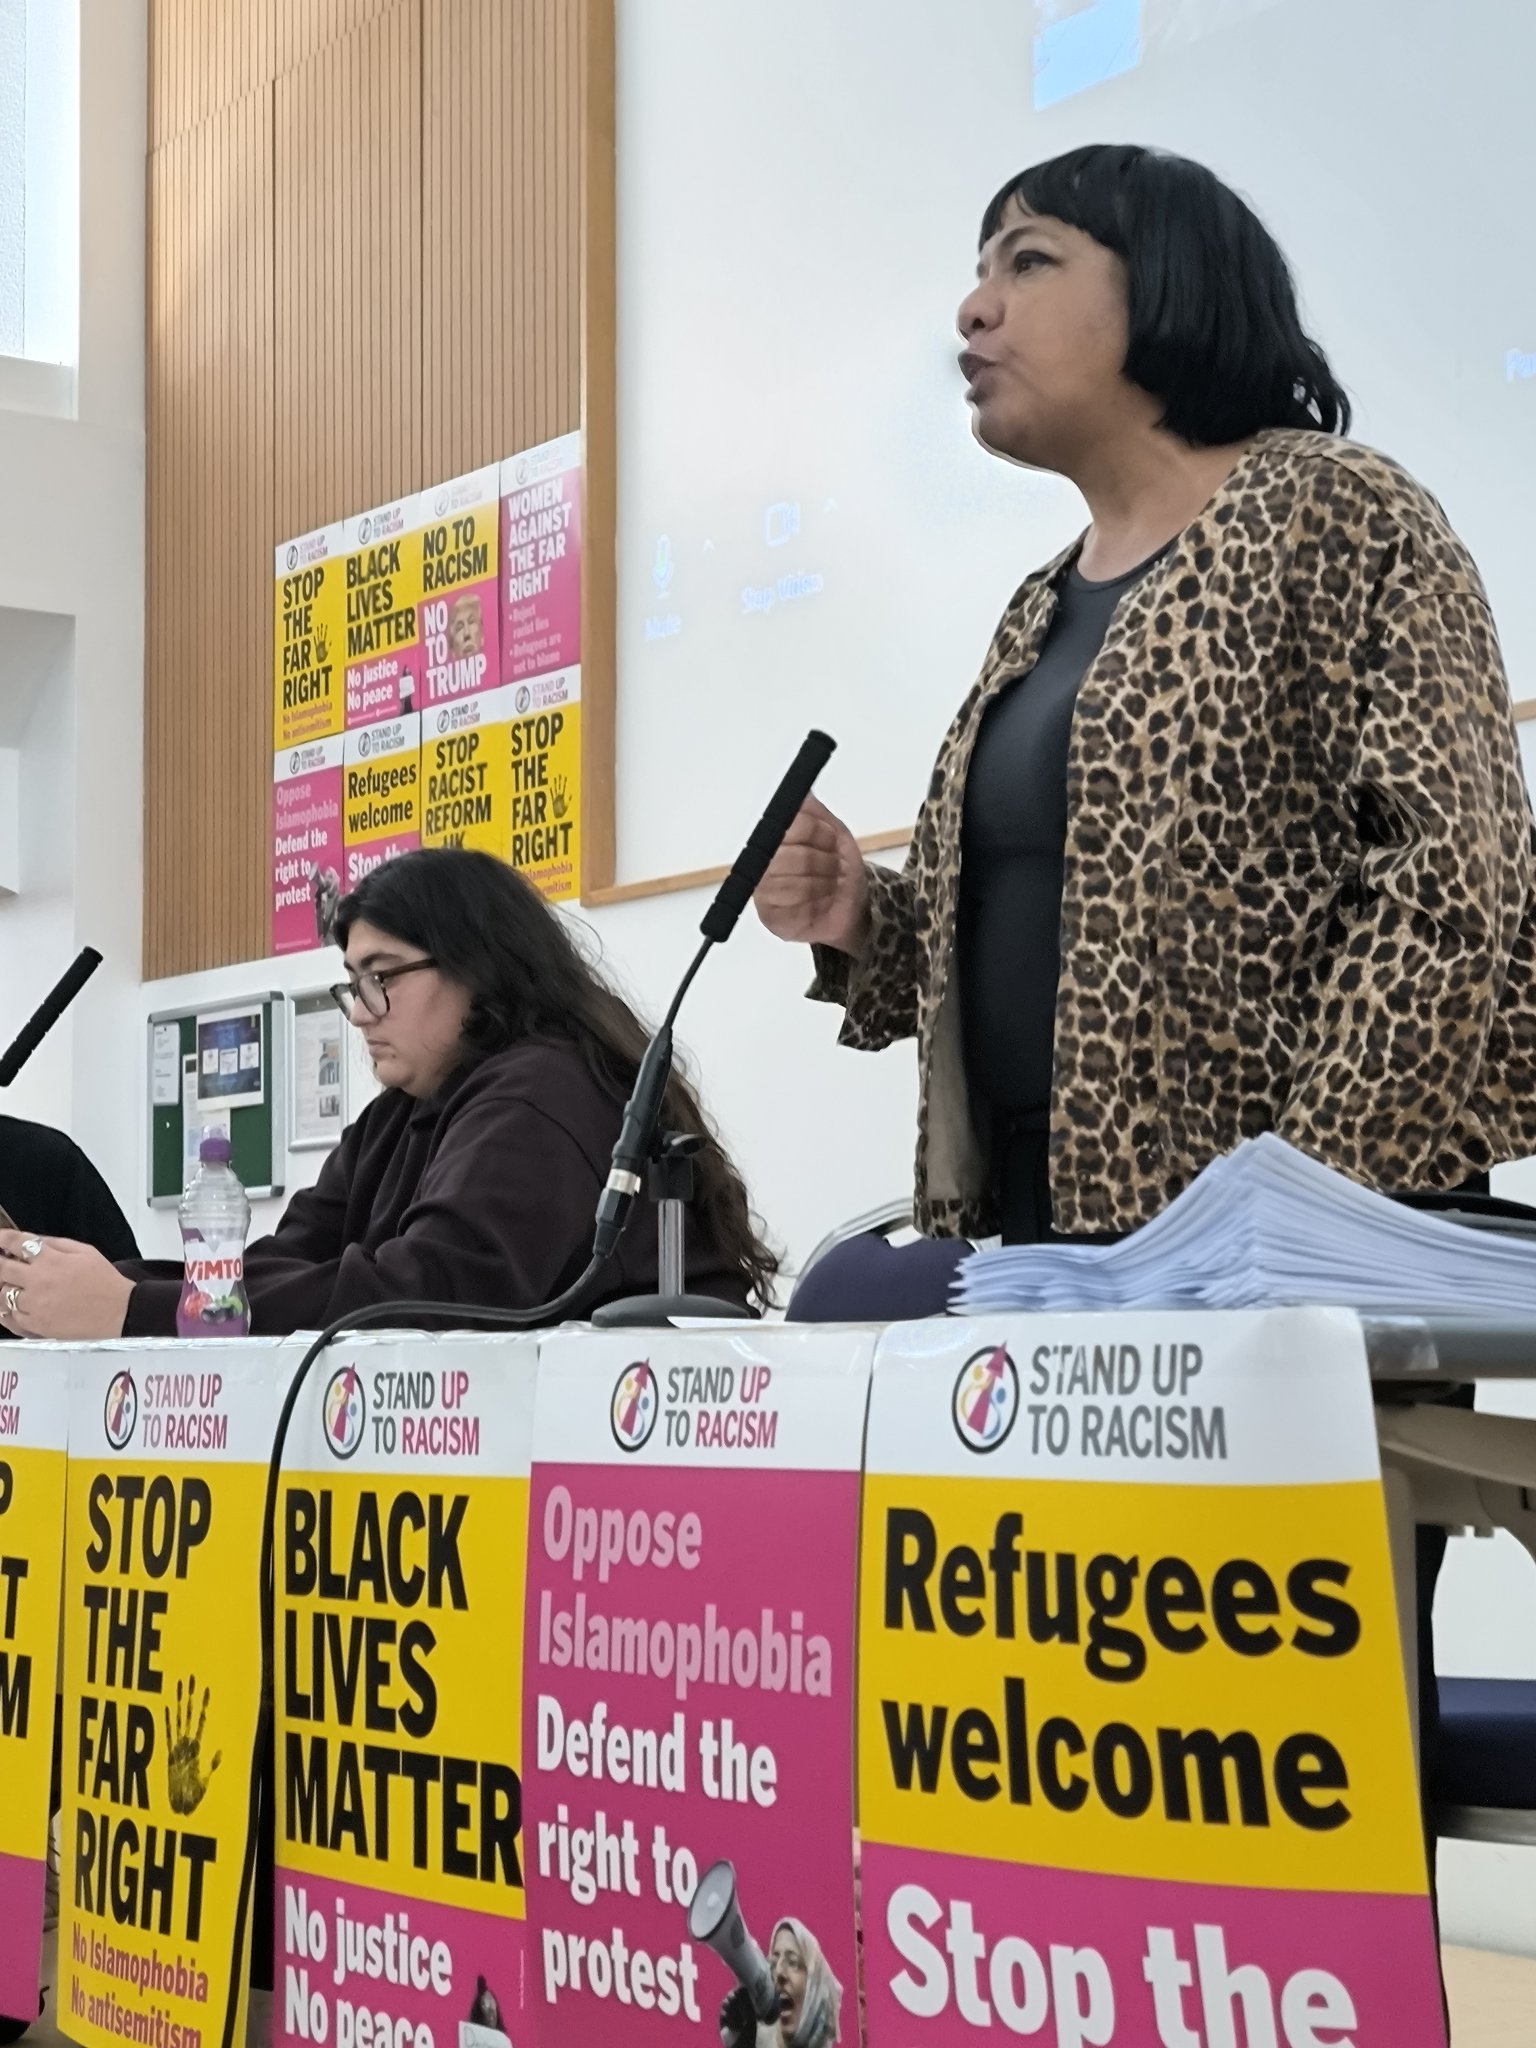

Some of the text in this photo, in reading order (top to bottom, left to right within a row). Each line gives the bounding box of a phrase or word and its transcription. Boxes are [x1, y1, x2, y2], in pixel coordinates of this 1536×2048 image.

[508, 477, 563, 520] WOMEN
[423, 515, 475, 561] NO TO
[508, 501, 572, 548] AGAINST
[346, 540, 401, 589] BLACK
[423, 542, 488, 593] RACISM
[509, 533, 565, 576] THE FAR
[283, 566, 325, 610] STOP
[346, 579, 393, 625] LIVES
[509, 565, 551, 604] RIGHT
[283, 604, 313, 642] THE
[347, 606, 416, 658] MATTER
[424, 600, 448, 636] NO
[283, 641, 311, 676] FAR
[425, 632, 448, 666] TO
[283, 664, 333, 710] RIGHT
[347, 659, 399, 690] No justice
[426, 653, 487, 700] TRUMP
[347, 684, 394, 712] No peace
[436, 732, 479, 770] STOP
[511, 712, 564, 756] STOP
[276, 783, 311, 808] Oppose
[348, 763, 417, 800] Refugees
[429, 763, 488, 804] RACIST
[511, 753, 549, 793] THE
[276, 800, 339, 831] Islamophobia
[348, 800, 413, 834] welcome
[425, 794, 492, 836] REFORM
[511, 791, 546, 831] FAR
[275, 828, 328, 857] Defend the
[512, 821, 573, 867] RIGHT
[275, 858, 311, 886] right to
[275, 883, 311, 913] protest
[1, 1371, 18, 1400] UP
[144, 1373, 223, 1409] STAND UP
[373, 1371, 469, 1410] STAND UP
[666, 1366, 771, 1404] STAND UP
[1029, 1343, 1203, 1396] STAND UP
[142, 1414, 228, 1449] TO RACISM
[372, 1416, 480, 1456] TO RACISM
[665, 1410, 778, 1448] TO RACISM
[1028, 1404, 1228, 1460] TO RACISM
[86, 1473, 212, 1580] STOP
[543, 1484, 702, 1583] Oppose
[285, 1488, 470, 1611] BLACK
[883, 1507, 1362, 1684] Refugees
[84, 1584, 169, 1694] THE
[538, 1589, 832, 1700] Islamophobia
[285, 1609, 437, 1739] LIVES
[77, 1695, 155, 1811] FAR
[537, 1694, 777, 1808] Defend the
[881, 1676, 1352, 1832] welcome
[285, 1731, 524, 1888] MATTER
[74, 1807, 217, 1943] RIGHT
[538, 1803, 698, 1908] right to
[72, 1921, 208, 2003] No Islamophobia
[285, 1885, 327, 1962] No
[333, 1897, 452, 1997] justice
[543, 1927, 701, 2023] protest
[886, 1884, 1358, 2048] Stop the
[71, 1974, 202, 2048] No antisemitism
[285, 1964, 435, 2048] No peace
